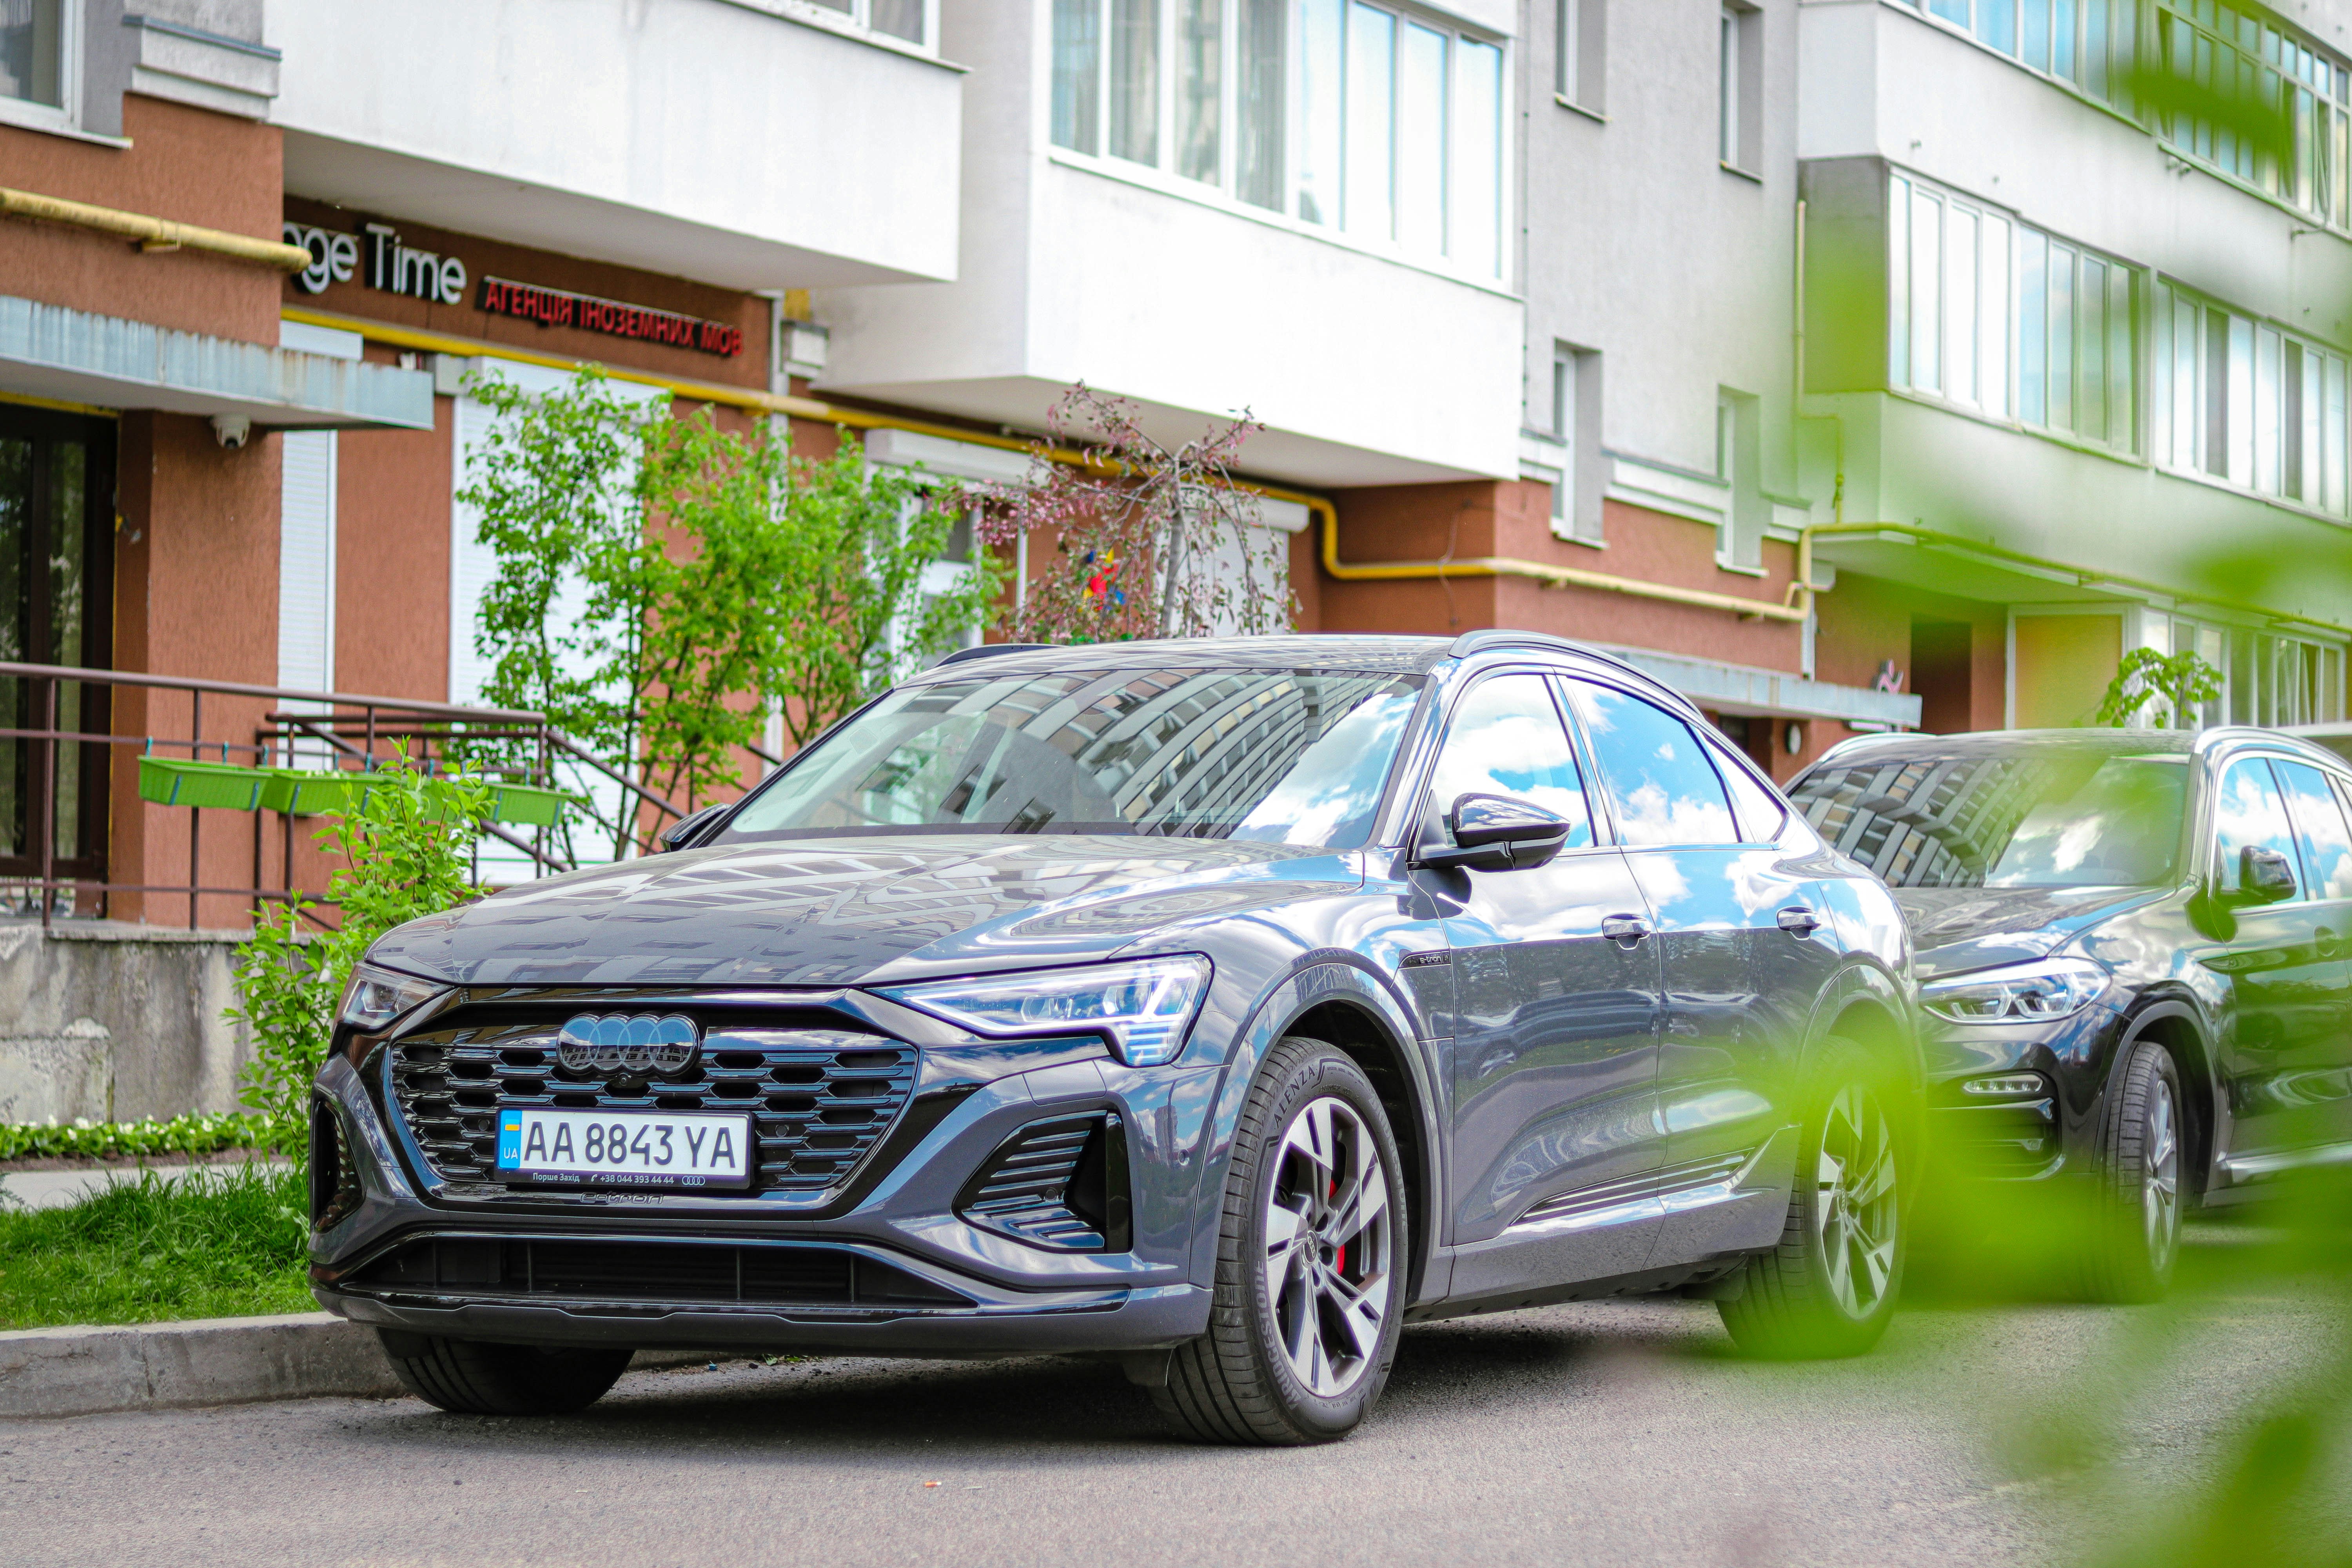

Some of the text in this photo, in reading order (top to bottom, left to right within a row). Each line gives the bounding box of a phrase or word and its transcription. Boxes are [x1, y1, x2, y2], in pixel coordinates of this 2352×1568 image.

[366, 222, 468, 305] Time
[485, 281, 742, 356] АГЕНЦІЯ ІНОЗЕМНИХ МОВ
[1419, 955, 1441, 964] e-tron
[1274, 1065, 1316, 1129] ALENZA
[503, 1147, 518, 1160] UA
[524, 1121, 736, 1169] AA 8843 YA
[532, 1172, 580, 1183] Порше Захід
[579, 1191, 666, 1205] e-tron
[1254, 1259, 1301, 1411] BRIDGESTONE
